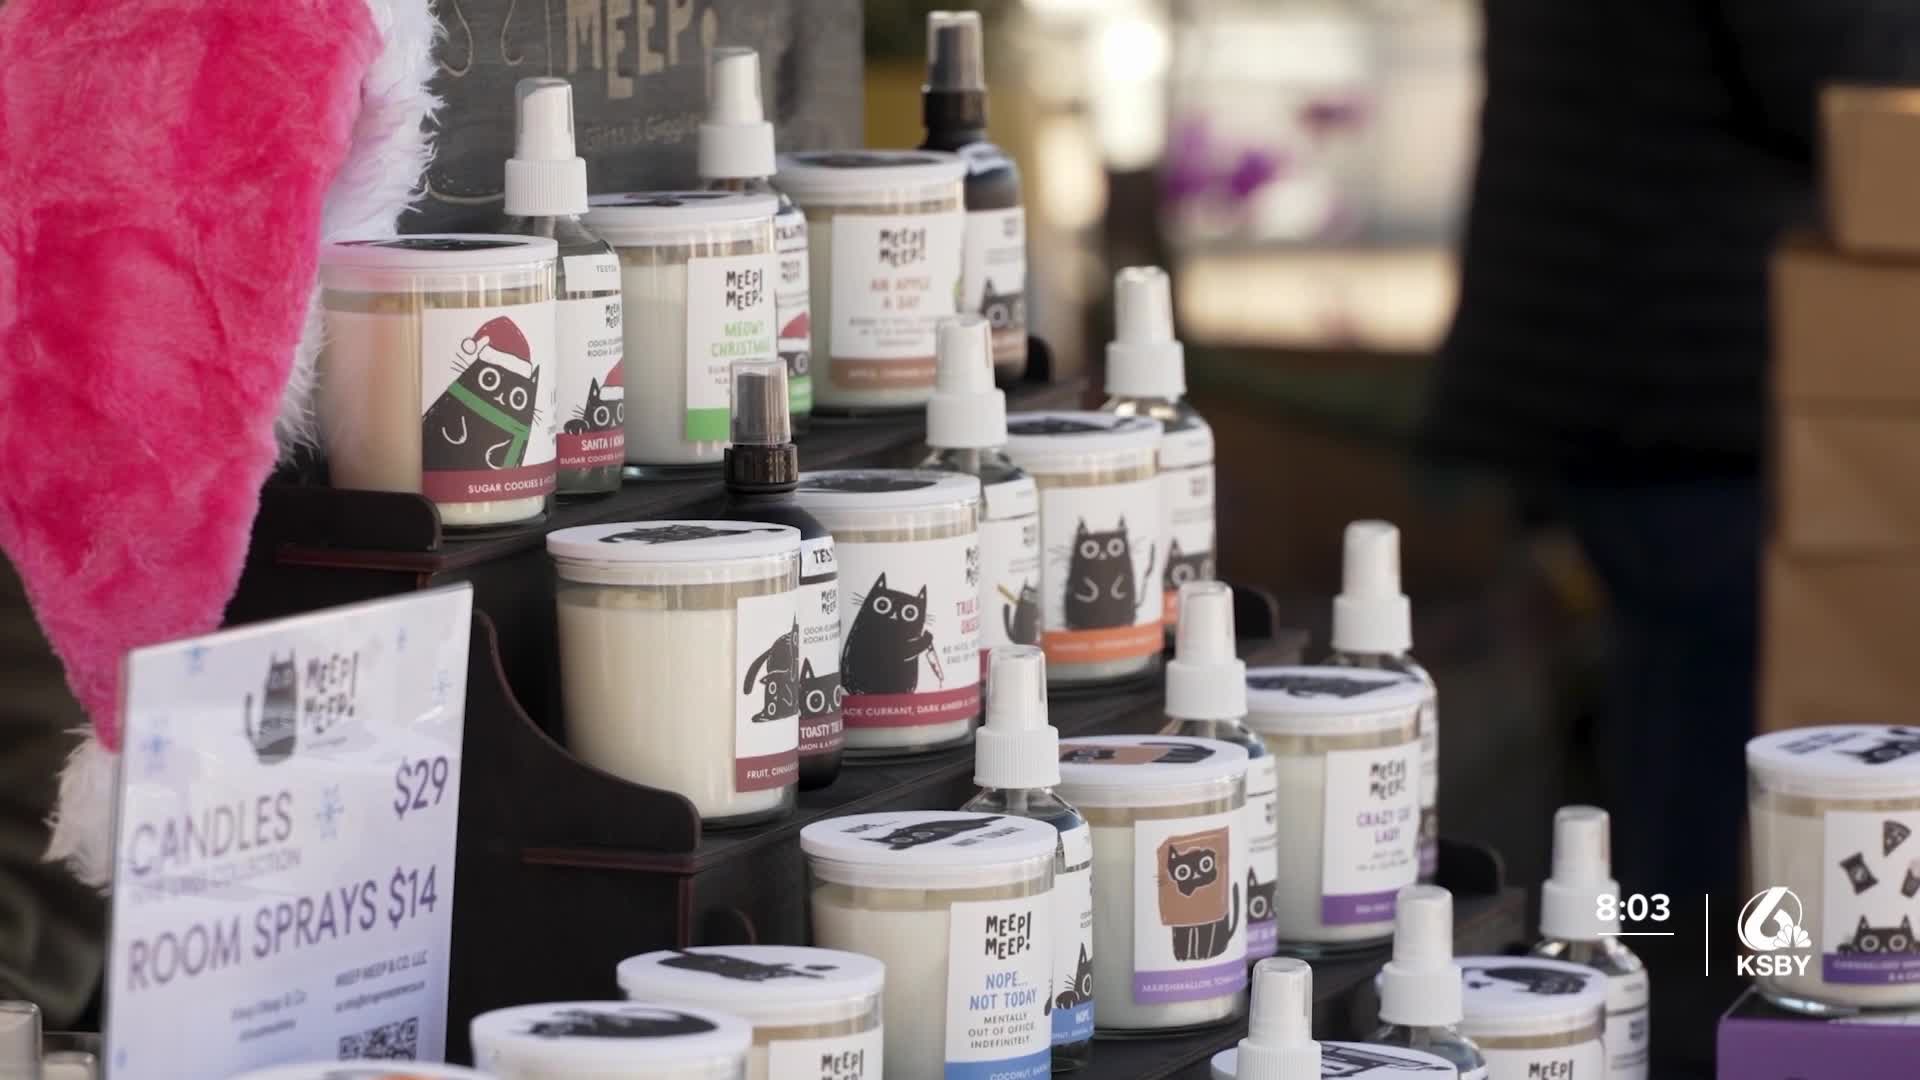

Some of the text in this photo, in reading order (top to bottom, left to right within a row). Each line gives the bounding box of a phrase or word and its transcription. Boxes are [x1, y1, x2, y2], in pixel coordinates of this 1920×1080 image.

[581, 437, 608, 452] SANTA
[560, 456, 586, 465] SUGAR
[467, 482, 502, 494] SUGAR
[504, 478, 538, 491] COOKIES
[917, 703, 940, 714] DARK
[129, 754, 450, 877] CANDLES $29
[126, 863, 438, 993] ROOM SPRAYS $14
[969, 987, 1038, 1011] NOT TODAY
[983, 1012, 1028, 1025] MENTALLY
[968, 1027, 989, 1038] OUT
[992, 1026, 1004, 1037] OF
